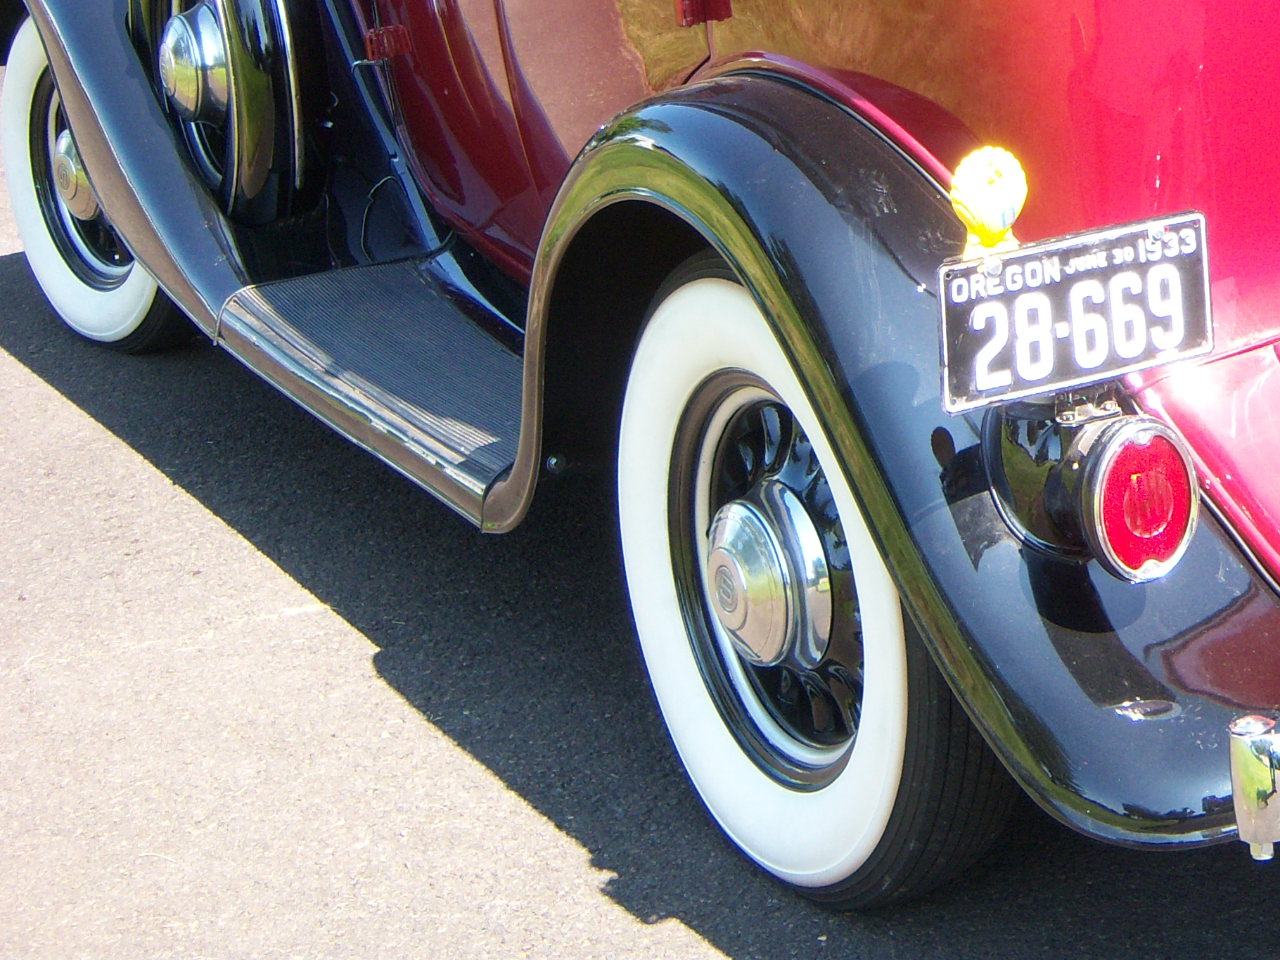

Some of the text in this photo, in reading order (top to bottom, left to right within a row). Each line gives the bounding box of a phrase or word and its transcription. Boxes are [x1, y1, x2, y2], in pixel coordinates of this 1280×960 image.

[951, 228, 1197, 303] OREGON JUNE 30 1933
[972, 263, 1185, 391] 28-669
